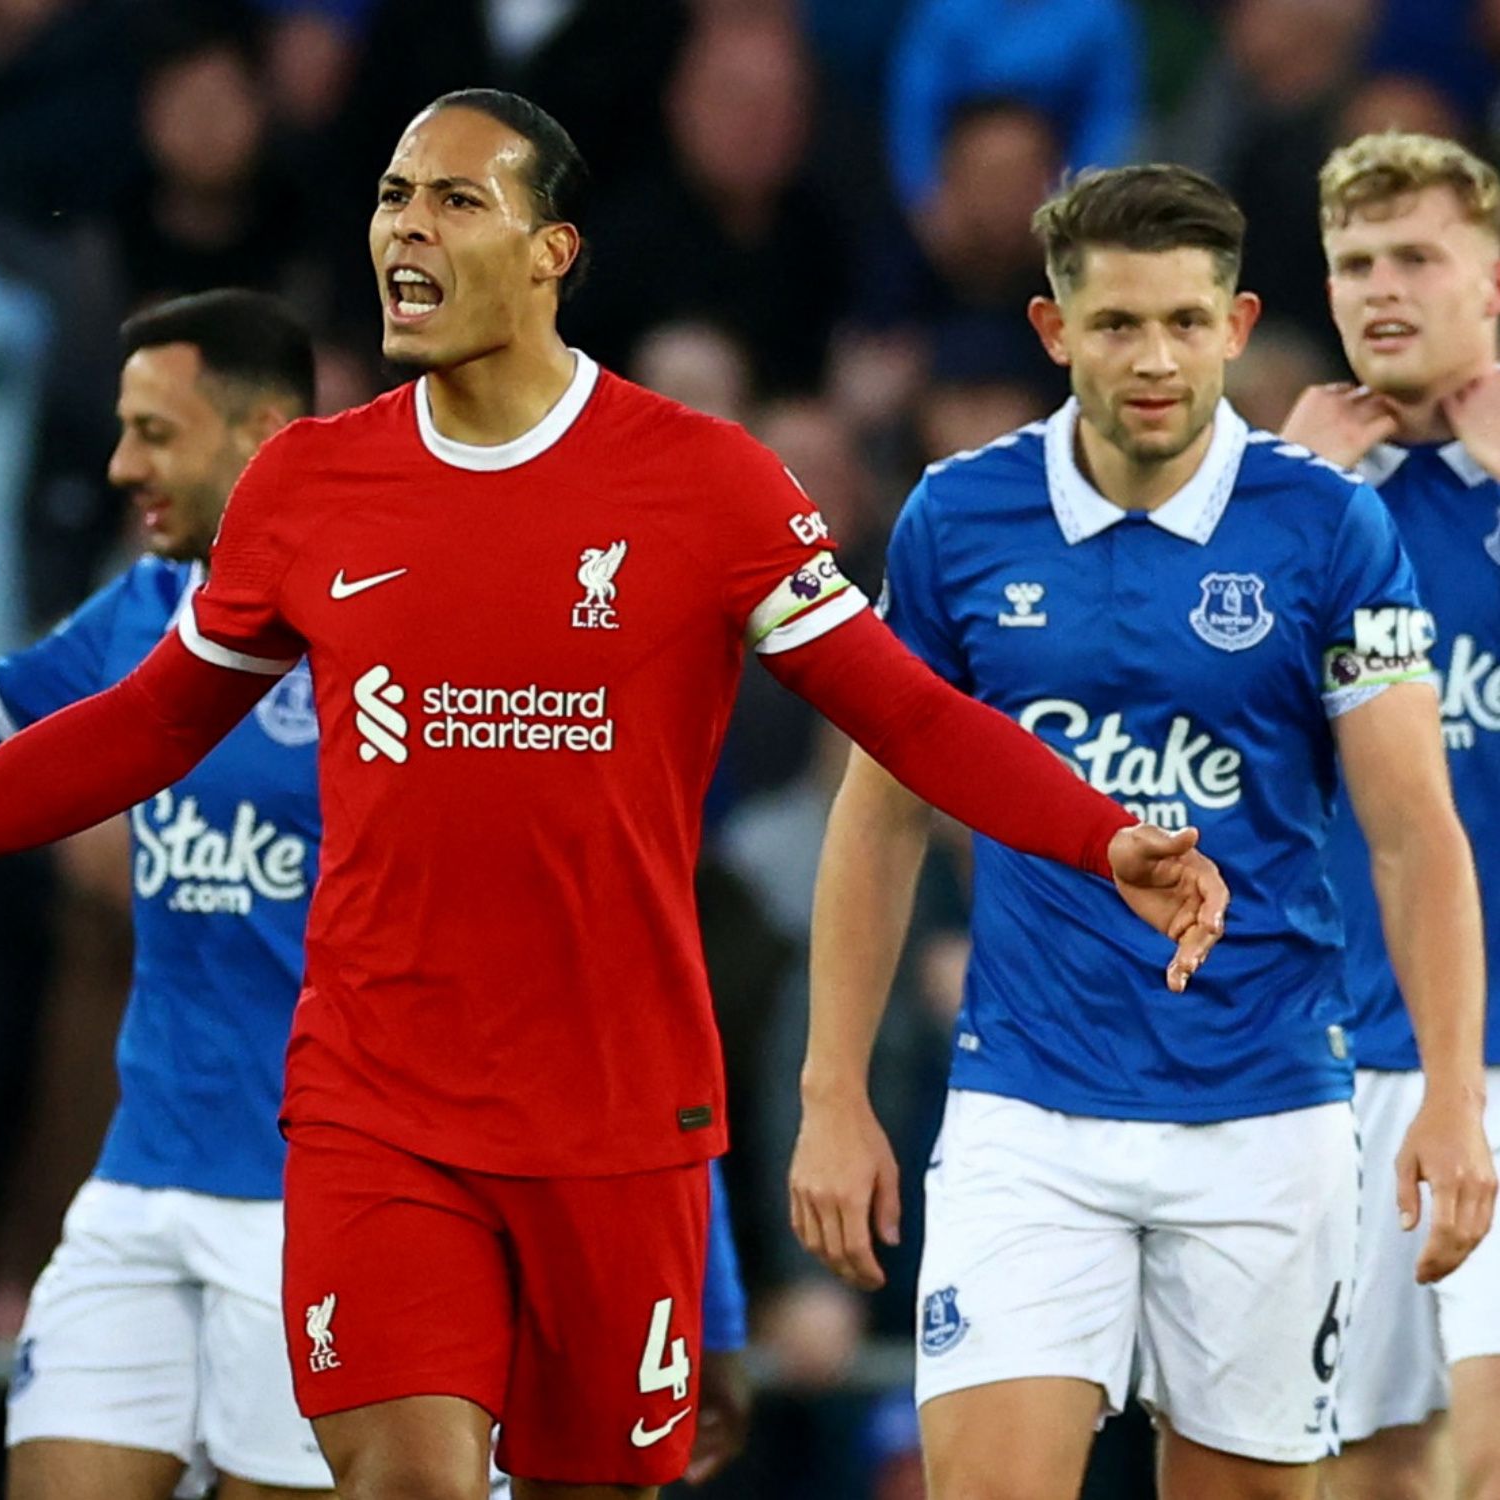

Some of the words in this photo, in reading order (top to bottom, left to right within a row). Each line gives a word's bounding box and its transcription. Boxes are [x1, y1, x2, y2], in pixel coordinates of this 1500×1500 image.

[423, 681, 606, 719] standard
[423, 715, 614, 752] chartered
[132, 787, 308, 899] Stake
[168, 883, 251, 915] .com
[638, 1297, 690, 1401] 4
[1312, 1280, 1342, 1384] 6
